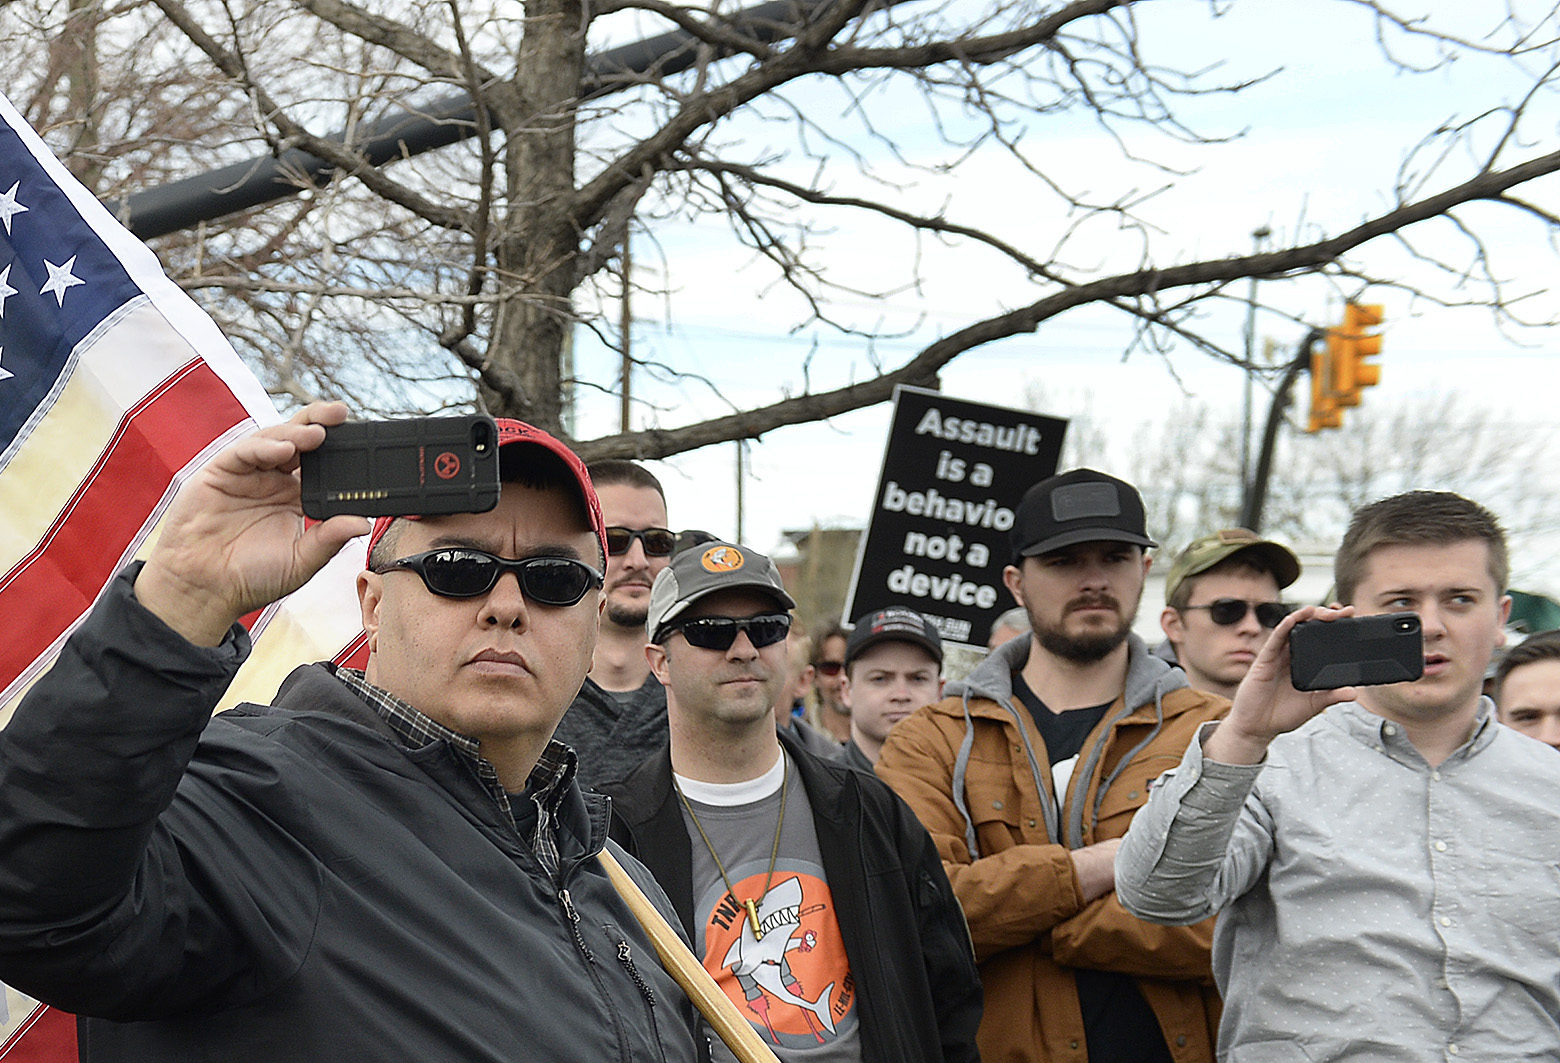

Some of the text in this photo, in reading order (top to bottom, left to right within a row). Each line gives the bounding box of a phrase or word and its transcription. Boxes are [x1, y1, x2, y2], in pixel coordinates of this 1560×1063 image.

[914, 407, 1042, 456] Assault
[935, 449, 994, 488] is a
[882, 480, 1017, 532] behavio
[902, 530, 990, 569] not a
[886, 565, 998, 609] device
